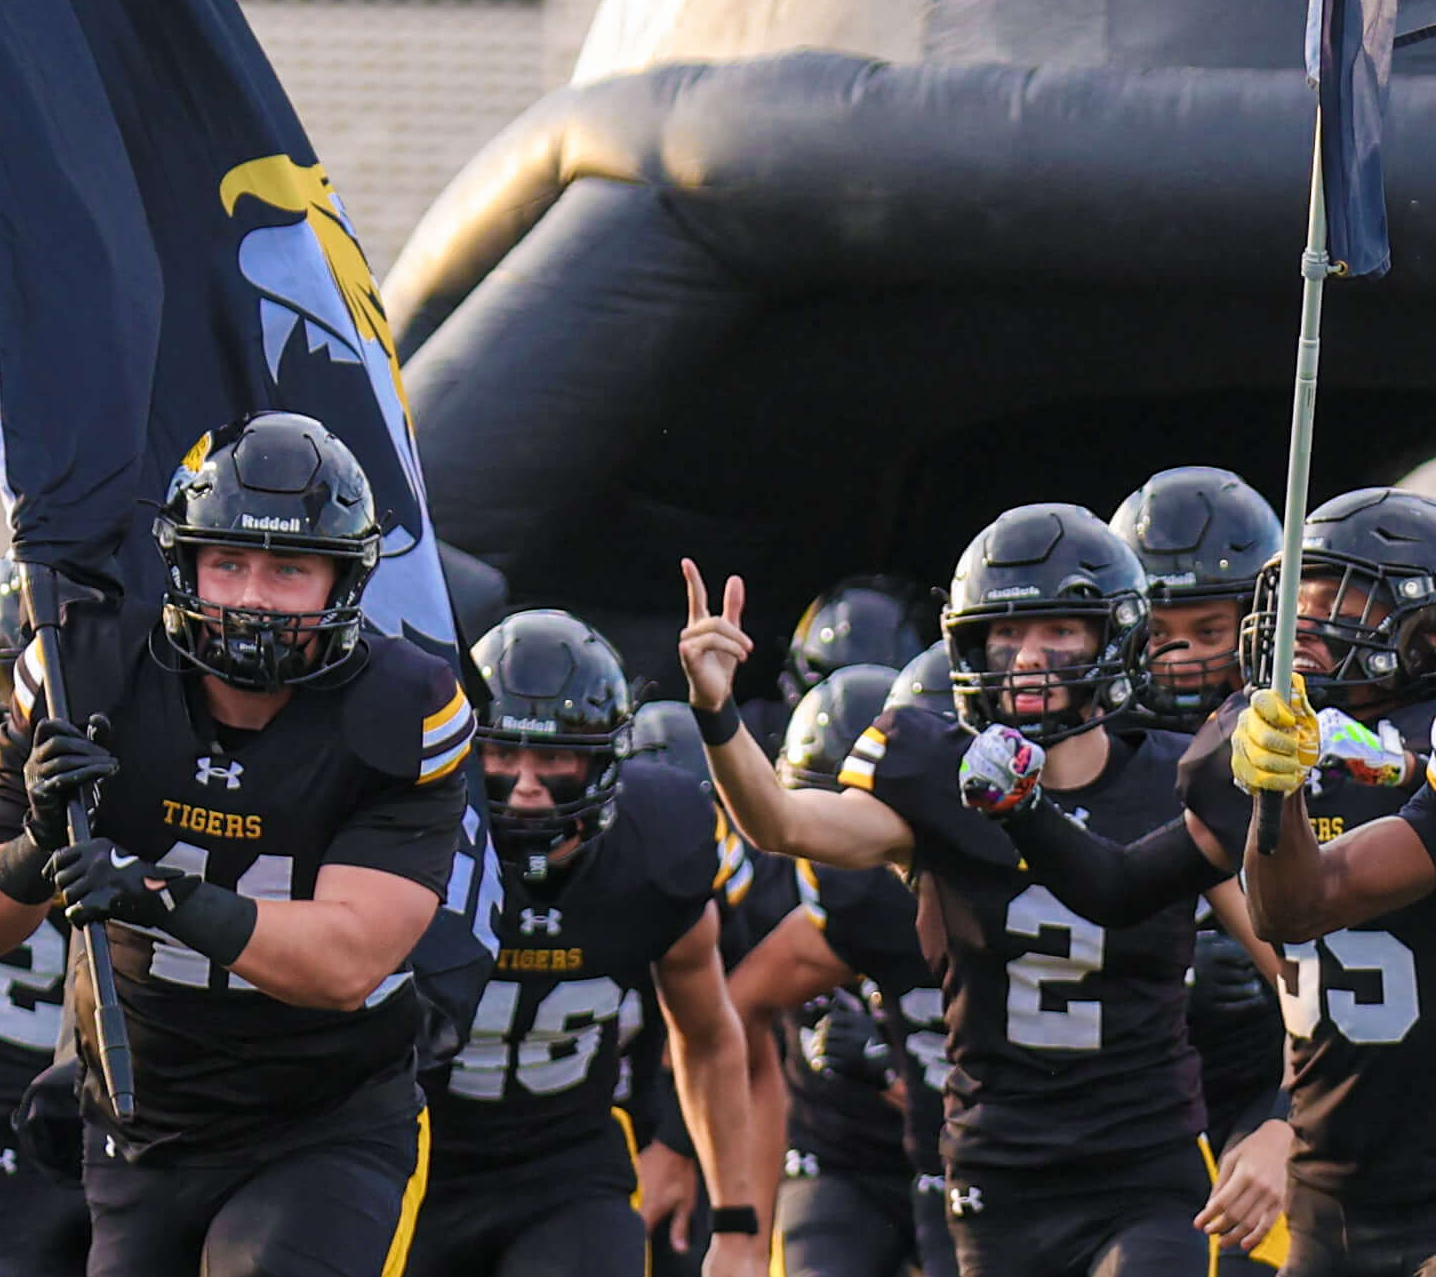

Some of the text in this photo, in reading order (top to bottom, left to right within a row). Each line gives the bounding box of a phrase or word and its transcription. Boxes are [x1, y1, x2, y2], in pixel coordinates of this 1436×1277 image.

[241, 513, 301, 533] Riddell
[163, 799, 263, 840] TIGERS
[497, 948, 583, 971] TIGERS
[1005, 884, 1106, 1051] 2
[448, 976, 624, 1102] 16
